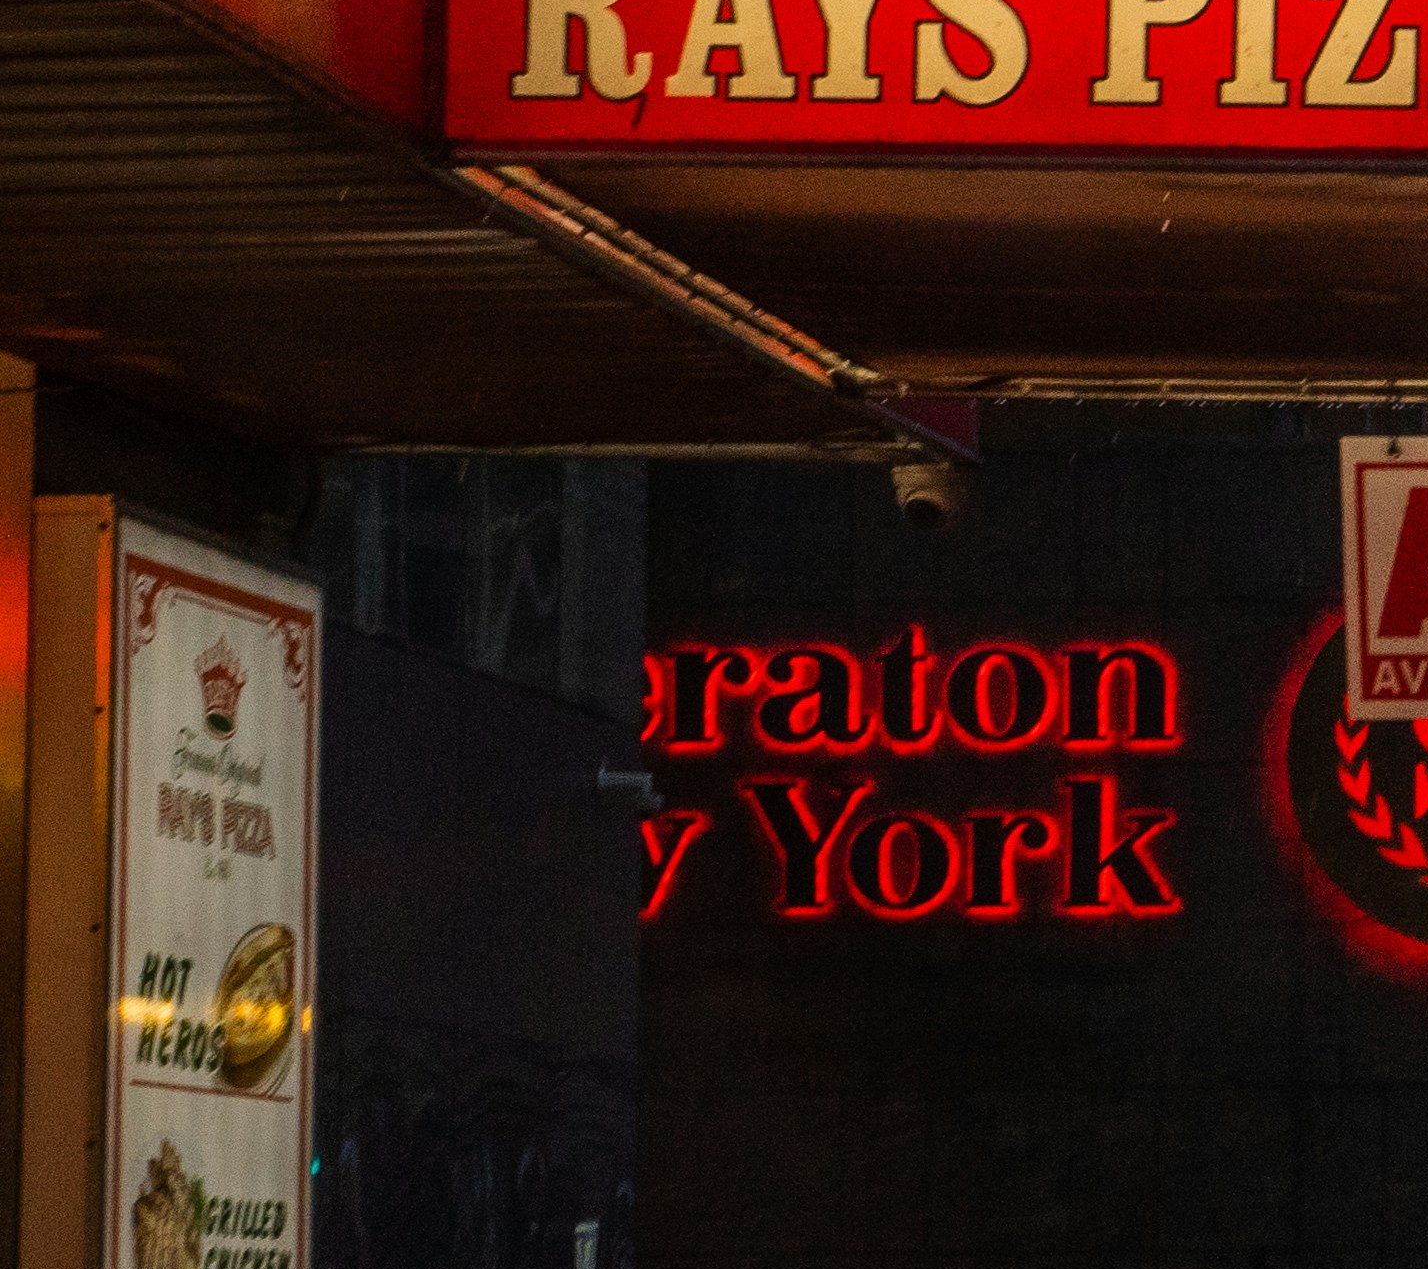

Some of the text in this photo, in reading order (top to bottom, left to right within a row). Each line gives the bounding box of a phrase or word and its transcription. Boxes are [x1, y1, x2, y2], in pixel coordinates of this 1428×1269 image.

[738, 774, 1185, 922] York
[139, 952, 194, 1007] HOT
[136, 1017, 225, 1074] HEROS
[203, 1195, 288, 1240] GRILLED
